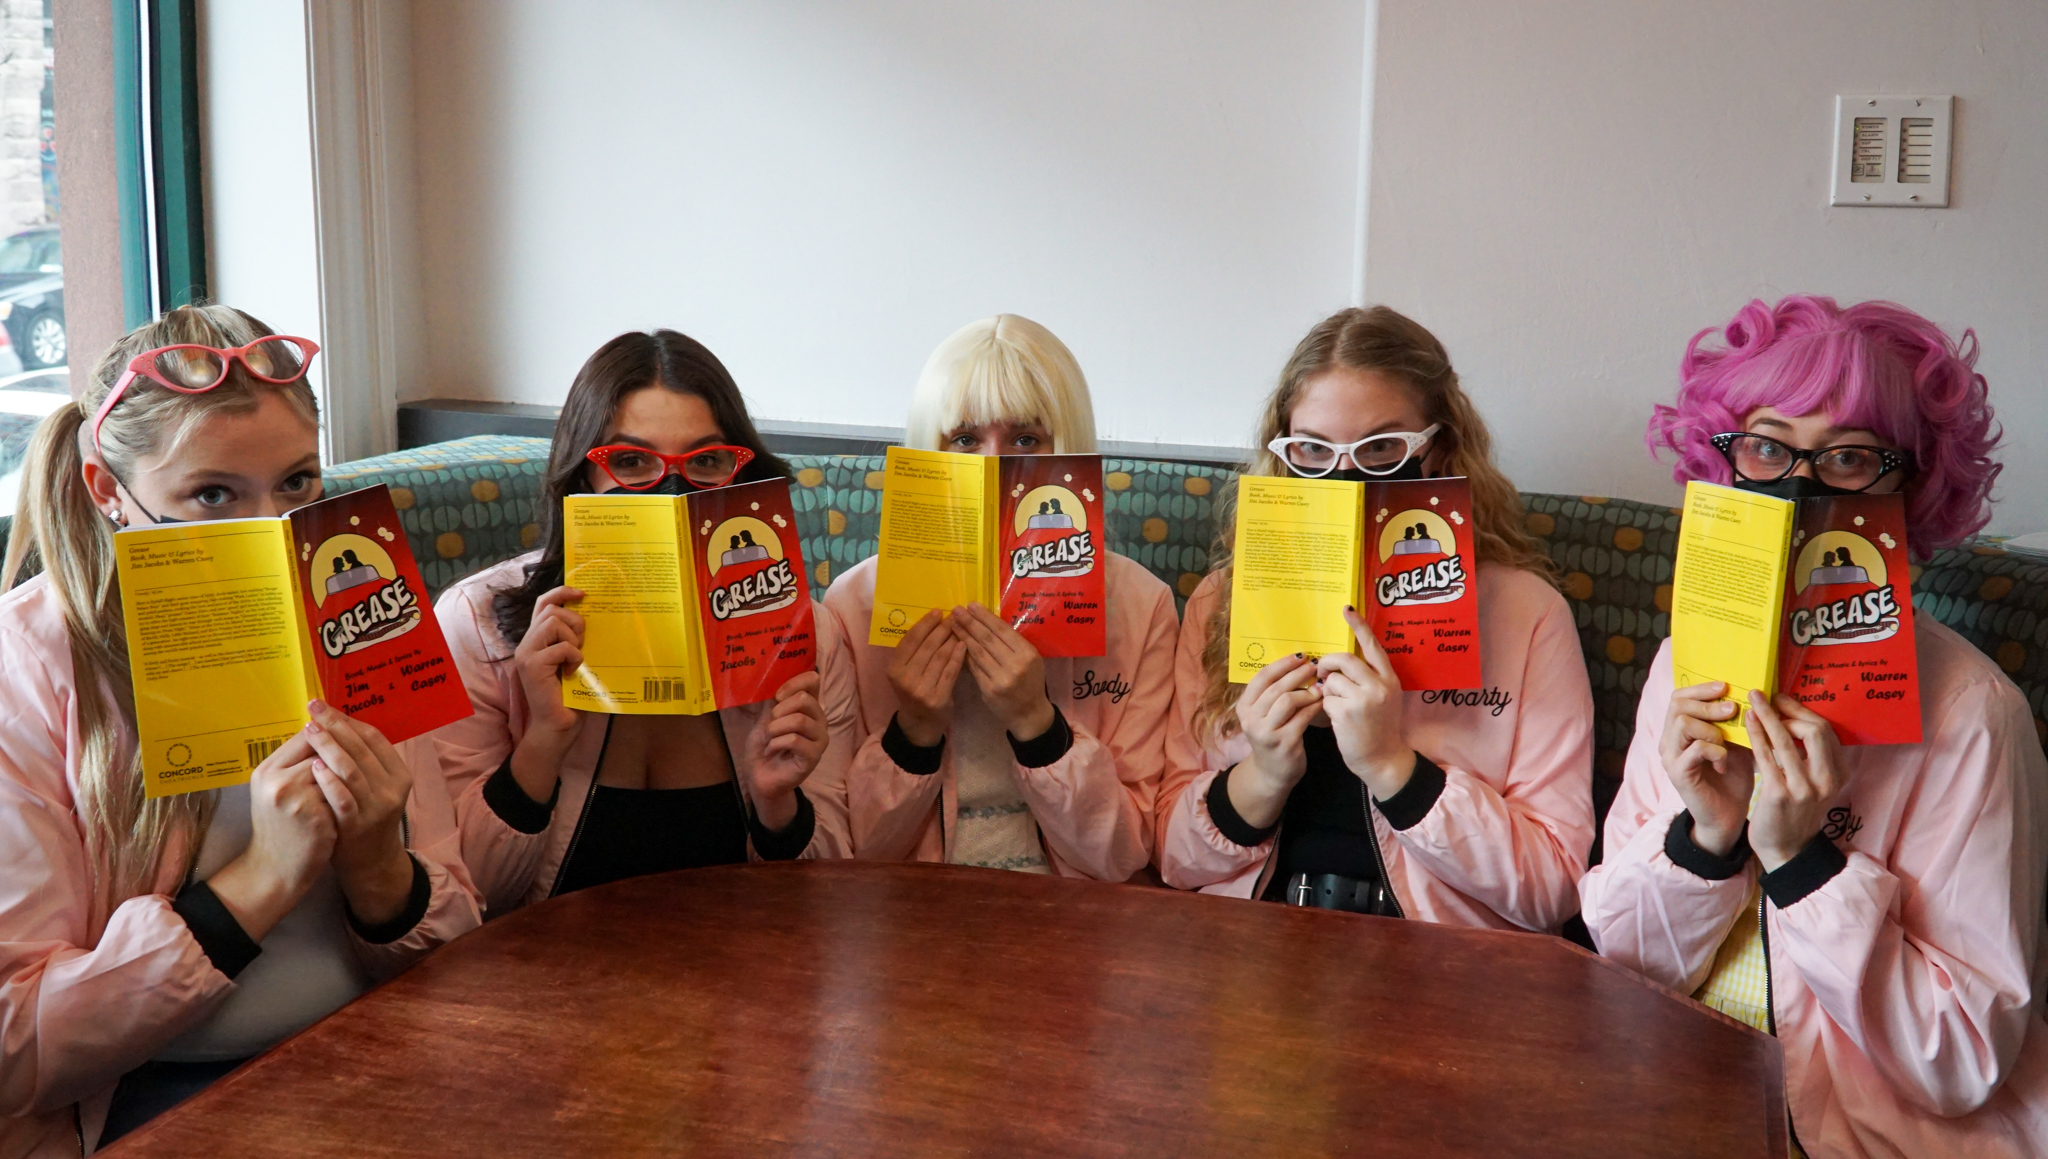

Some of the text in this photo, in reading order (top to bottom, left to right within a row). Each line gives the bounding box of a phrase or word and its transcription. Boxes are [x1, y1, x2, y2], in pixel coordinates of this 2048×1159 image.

[1011, 530, 1094, 579] GREASE
[1376, 554, 1464, 608] GREASE
[711, 558, 795, 621] GREASE
[1018, 601, 1036, 611] Jim
[1064, 601, 1098, 609] Warren
[322, 576, 415, 658] GREASE
[1066, 615, 1095, 624] Casey
[1789, 584, 1897, 645] GREASE
[773, 633, 809, 645] Warren
[1385, 630, 1405, 641] Jim
[1434, 629, 1471, 637] Warren
[726, 645, 745, 656] Jim
[778, 648, 808, 659] Casey
[1382, 644, 1413, 654] acobs
[1437, 643, 1469, 653] Casey
[401, 657, 444, 676] Warren
[720, 656, 756, 673] Jacobs
[411, 673, 446, 691] Casey
[1801, 675, 1824, 688] Jim
[1861, 672, 1907, 682] Warren
[345, 683, 369, 698] Jim
[1866, 689, 1905, 700] Casey
[342, 694, 385, 716] Jacobs
[1421, 686, 1513, 717] Marty
[159, 766, 203, 779] CONCORD
